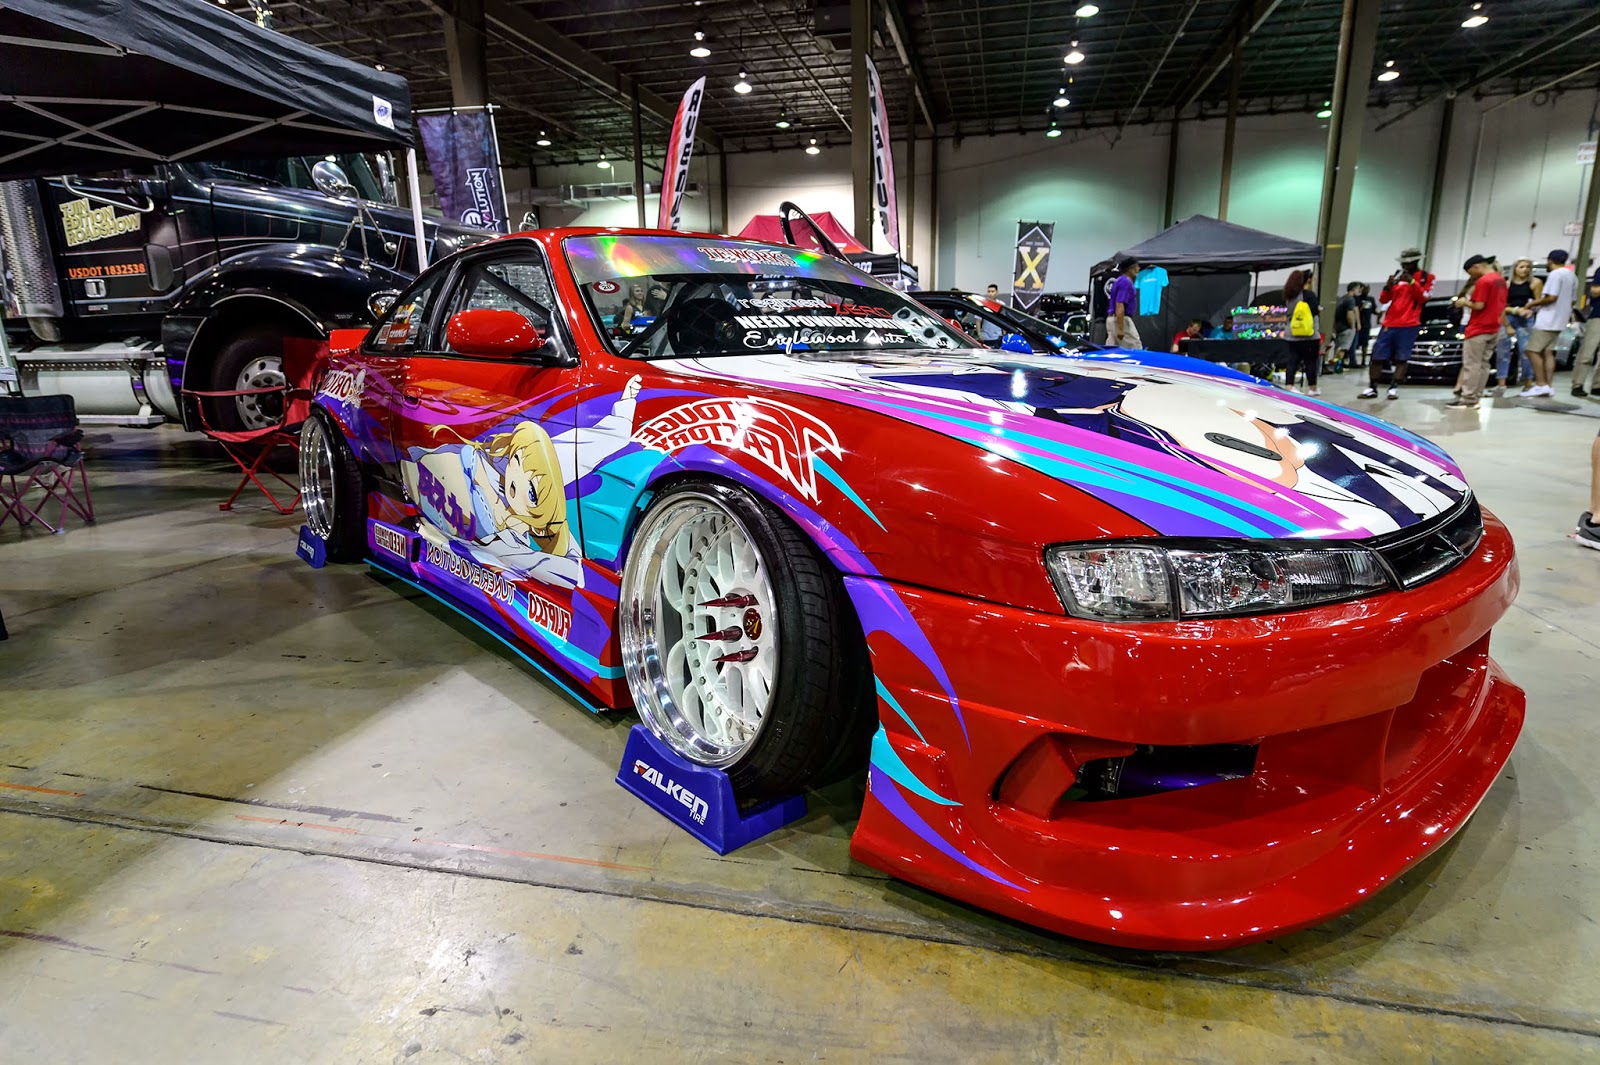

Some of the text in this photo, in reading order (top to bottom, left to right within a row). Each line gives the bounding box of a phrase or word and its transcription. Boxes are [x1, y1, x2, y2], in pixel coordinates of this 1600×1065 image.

[63, 206, 115, 231] EDITION
[67, 213, 140, 246] ROADSHOW
[68, 263, 146, 278] USDOT 1832538
[1014, 246, 1050, 289] X
[734, 315, 791, 329] NEED
[785, 315, 863, 329] POWDER
[743, 330, 860, 354] Englewood
[863, 329, 908, 346] Auto
[633, 759, 709, 819] FALKEN
[689, 809, 705, 826] TIRE
